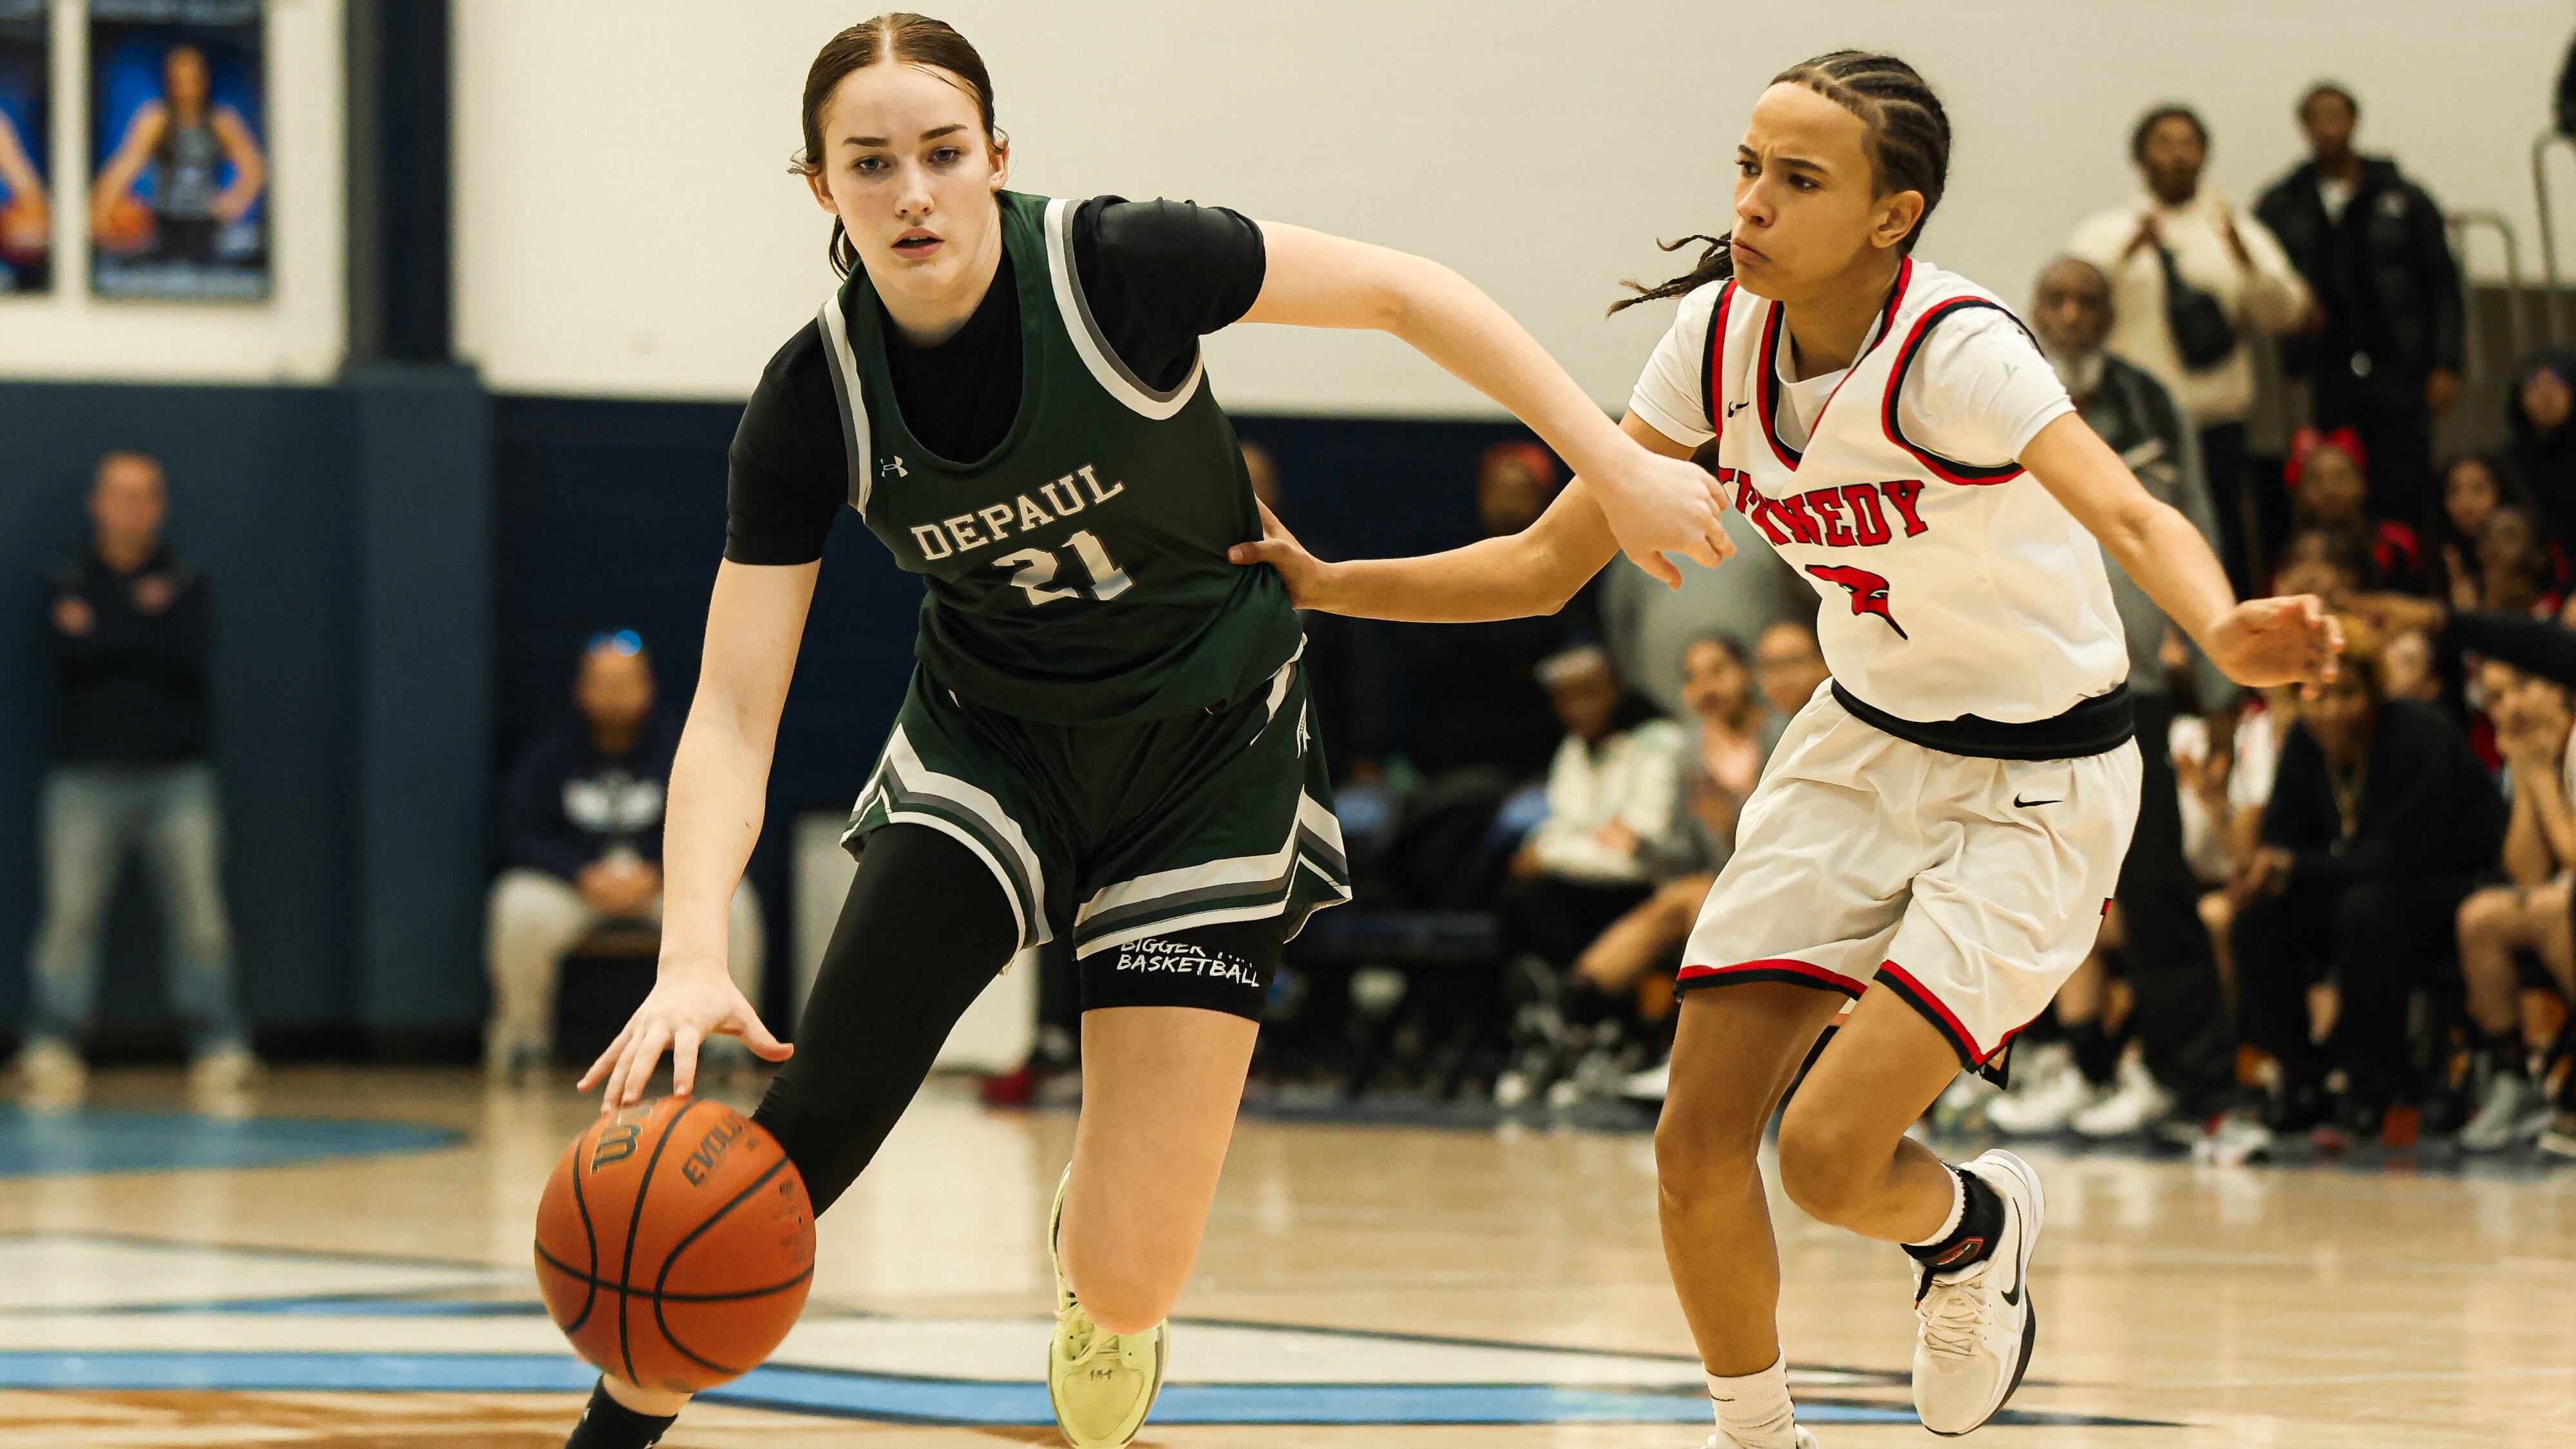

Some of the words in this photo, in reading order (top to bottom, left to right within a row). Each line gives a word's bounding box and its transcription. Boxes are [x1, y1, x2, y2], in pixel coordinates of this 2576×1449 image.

[911, 464, 1124, 561] DEPAUL
[991, 530, 1133, 606] 21
[1117, 954, 1260, 988] BASKETBALL
